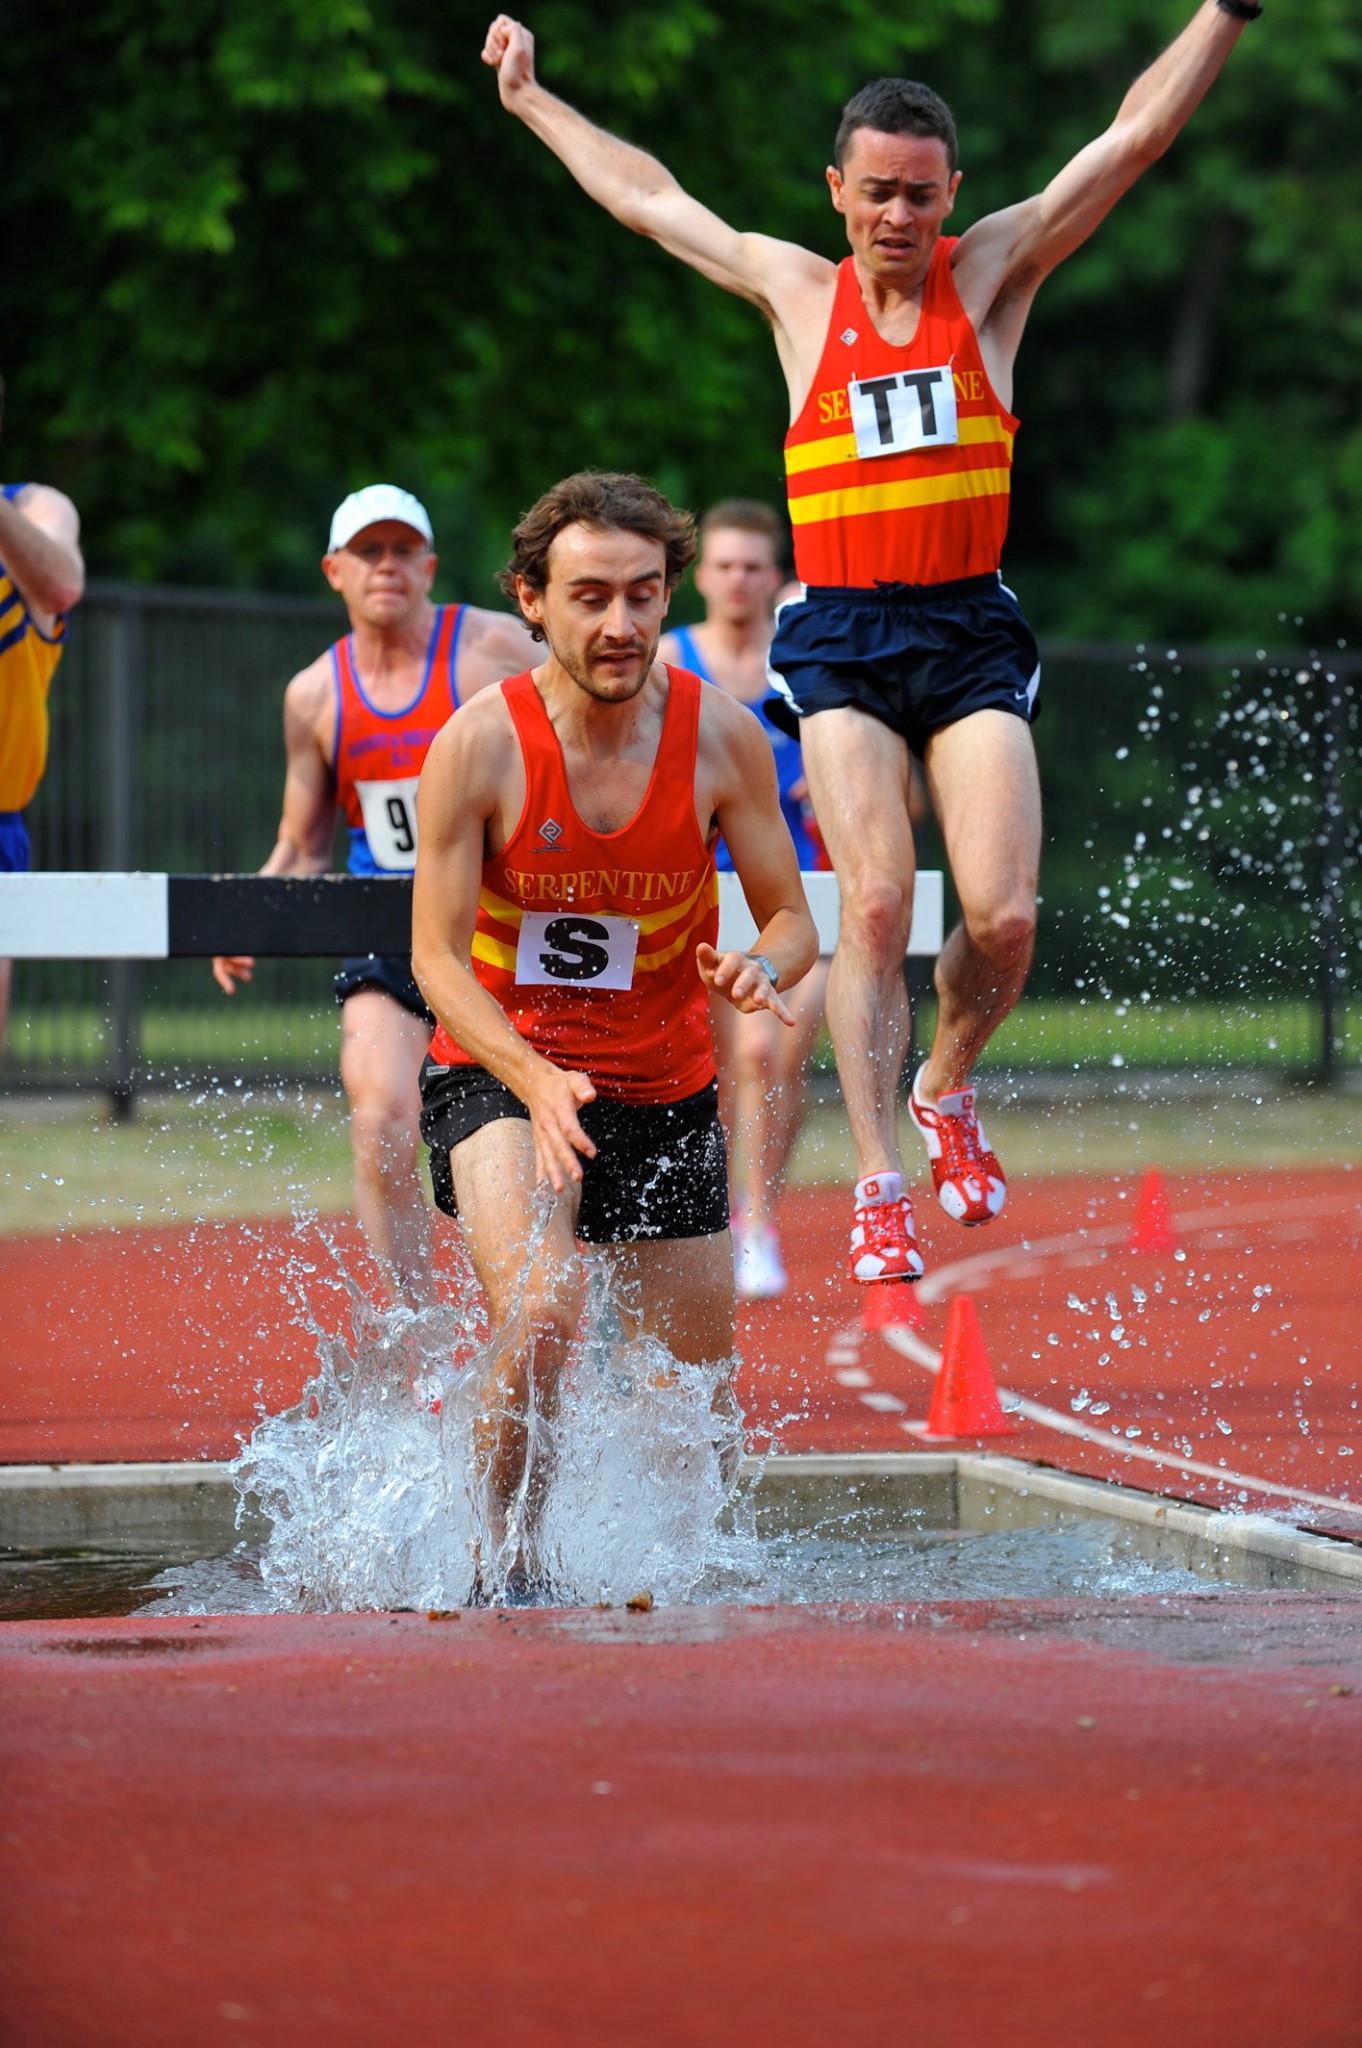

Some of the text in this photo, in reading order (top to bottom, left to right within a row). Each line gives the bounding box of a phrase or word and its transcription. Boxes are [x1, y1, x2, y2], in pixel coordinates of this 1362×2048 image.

[859, 370, 942, 445] TT
[385, 792, 418, 853] 9
[504, 867, 696, 901] SERPENTINE
[539, 917, 610, 980] S
